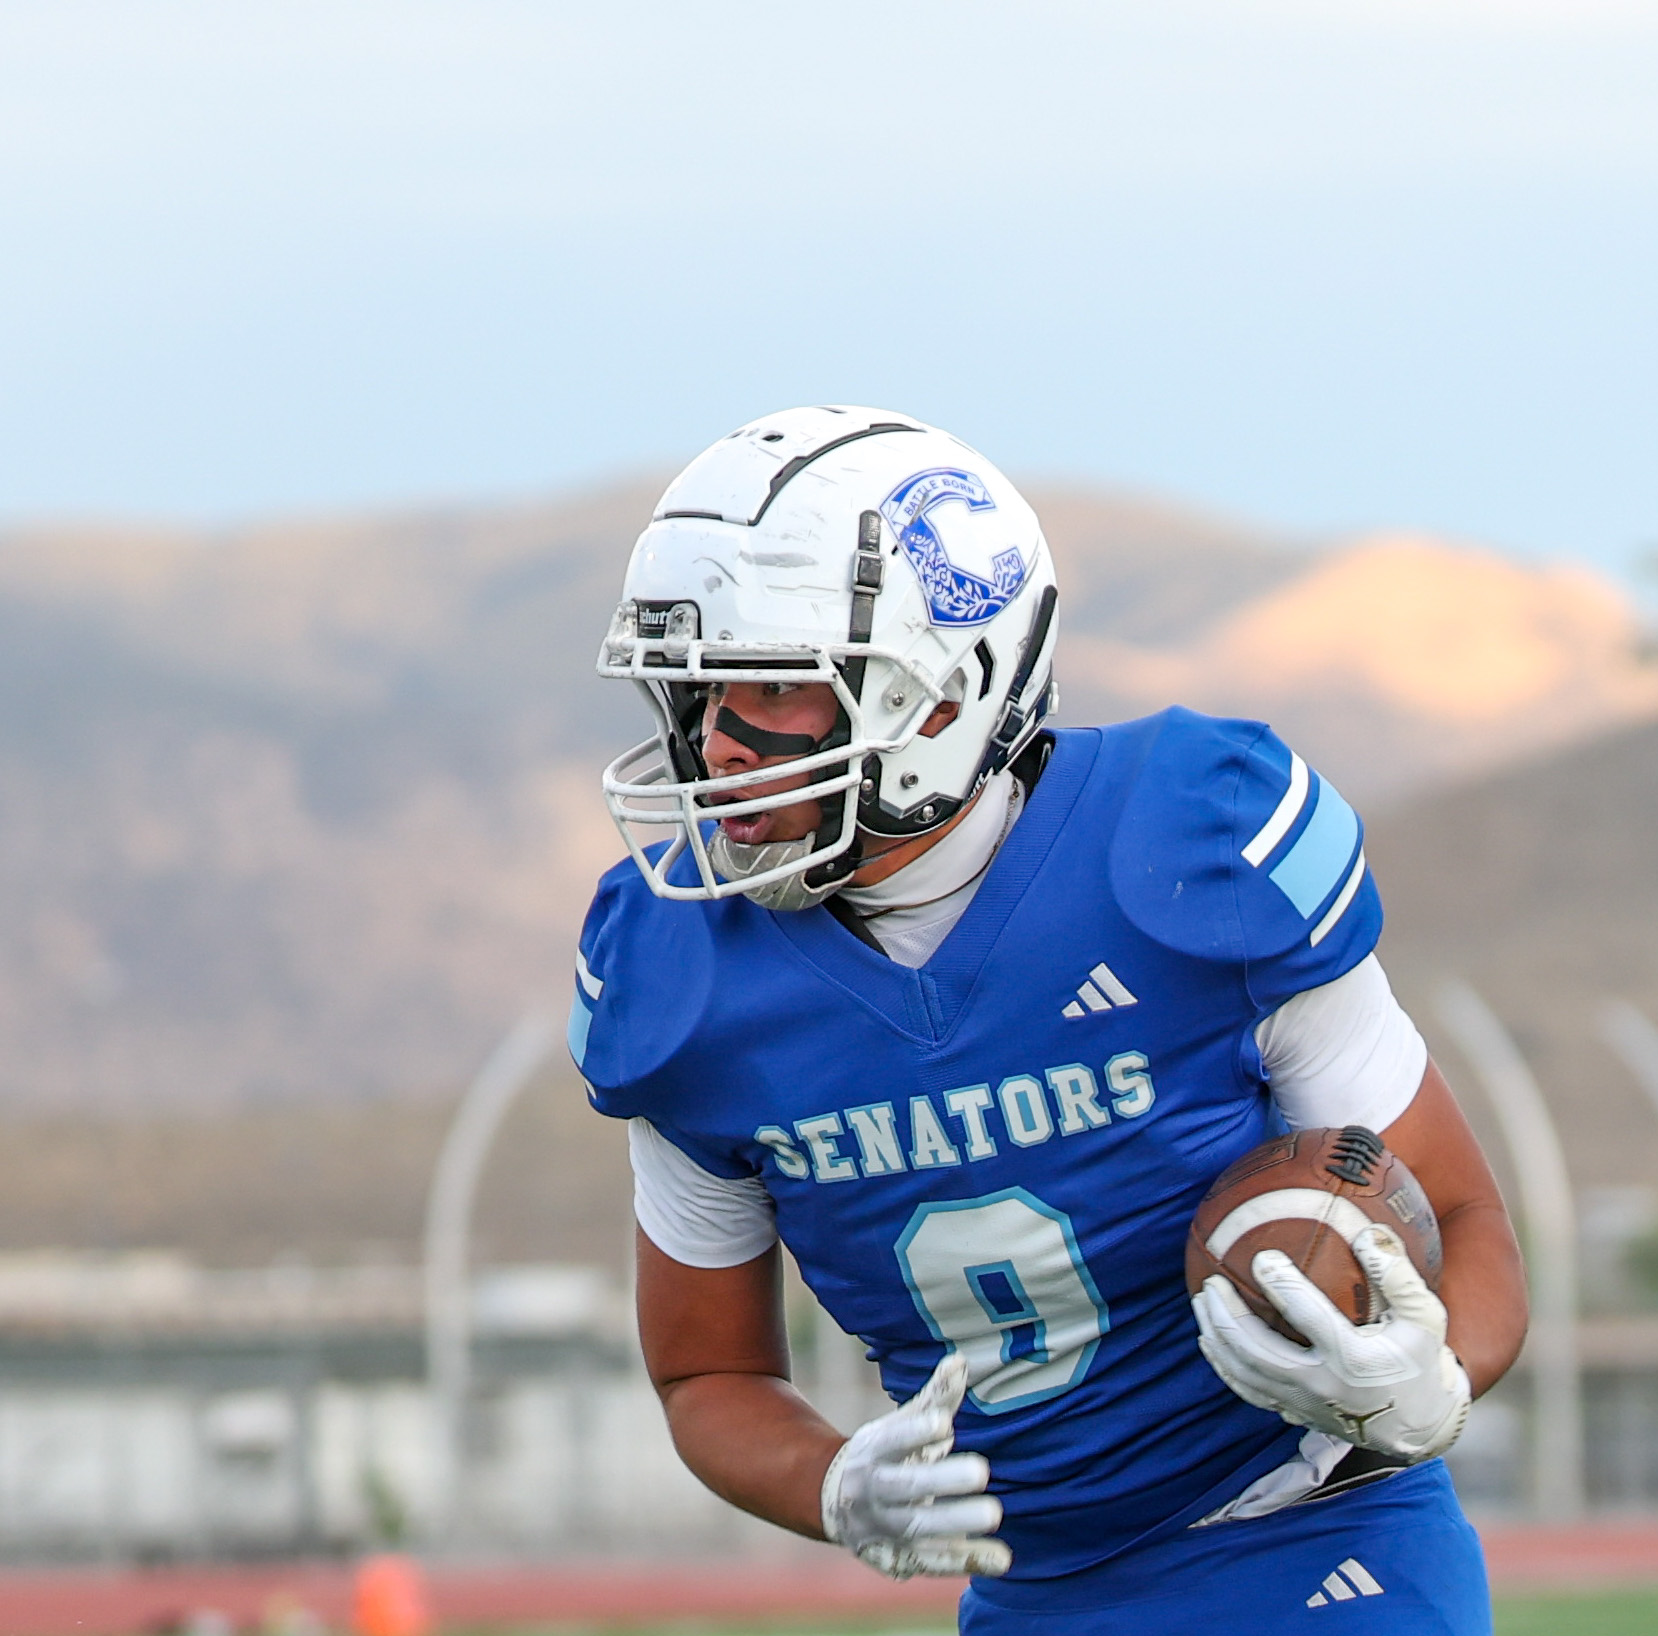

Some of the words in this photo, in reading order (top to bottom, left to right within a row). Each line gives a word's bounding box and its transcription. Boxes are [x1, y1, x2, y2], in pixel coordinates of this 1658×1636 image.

[904, 480, 939, 516] BATTLE
[941, 479, 976, 496] BORN
[754, 1050, 1156, 1184] SENATORS
